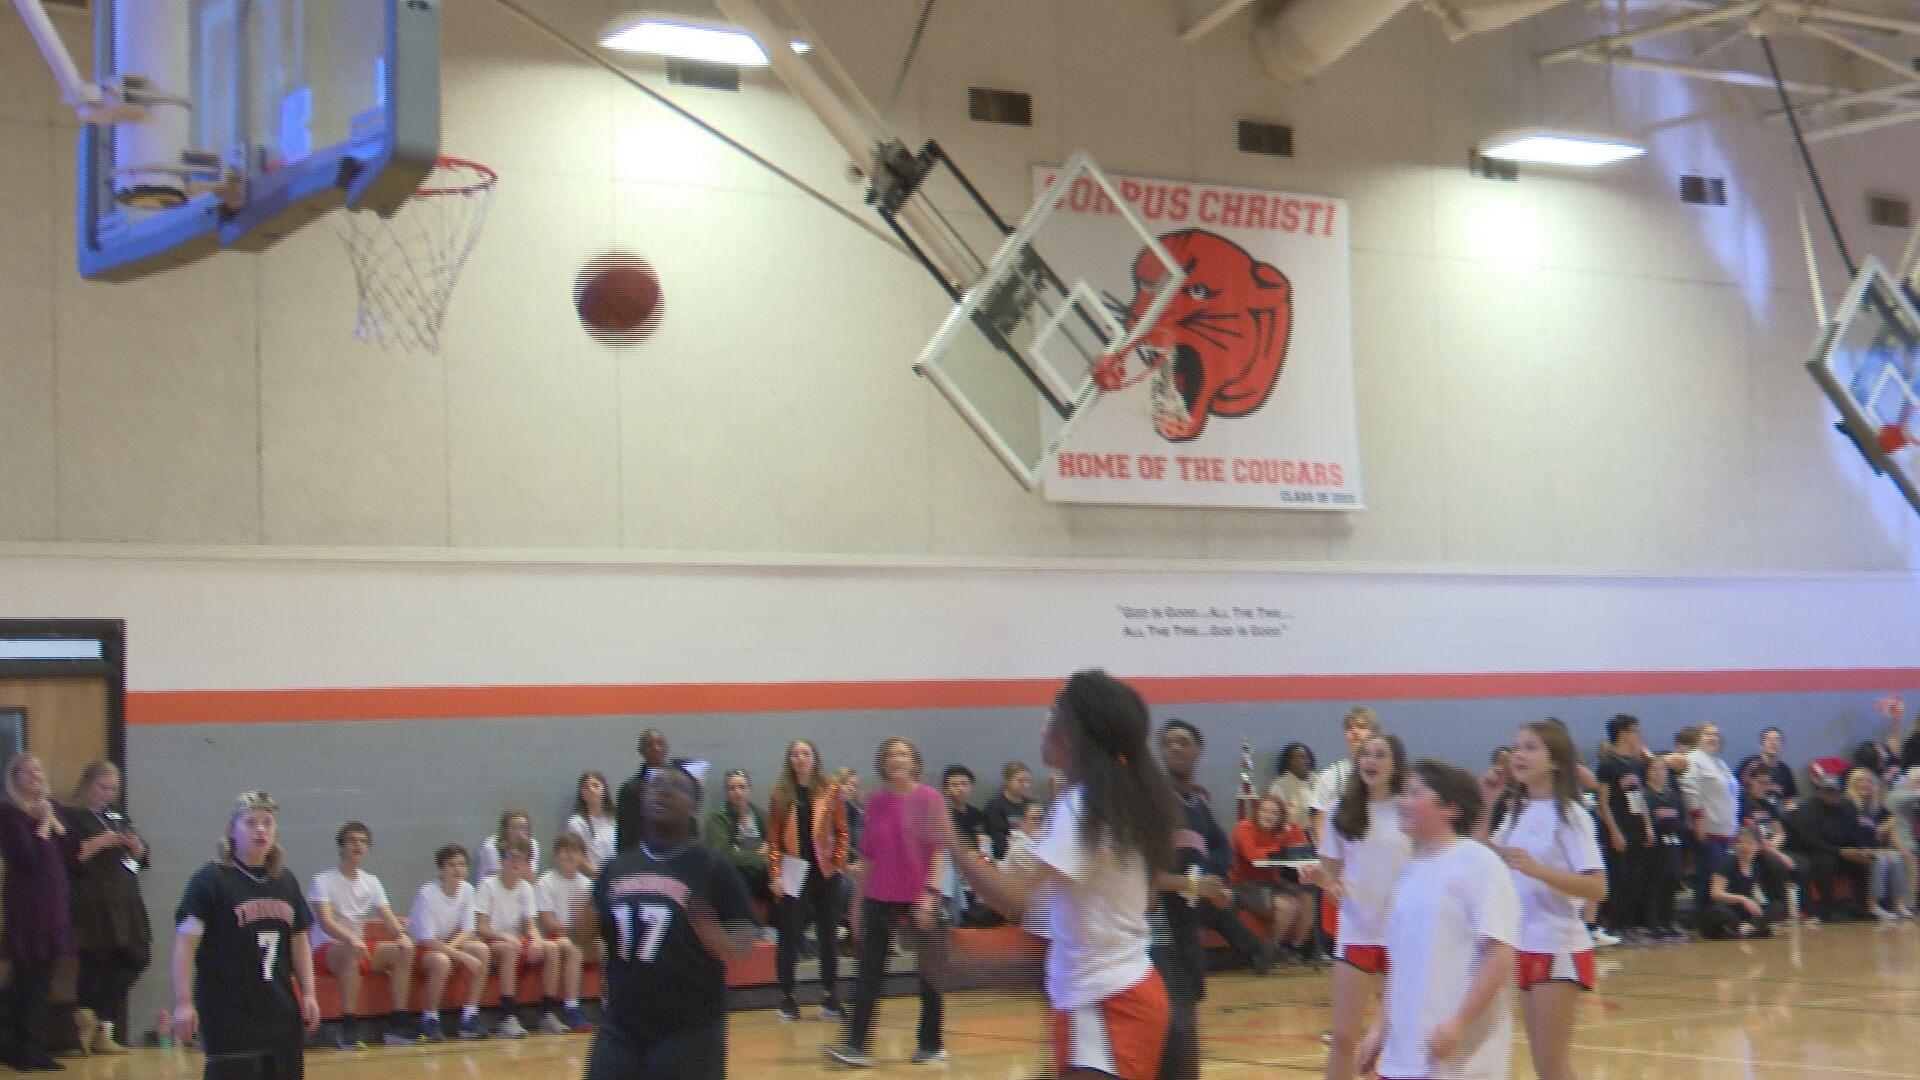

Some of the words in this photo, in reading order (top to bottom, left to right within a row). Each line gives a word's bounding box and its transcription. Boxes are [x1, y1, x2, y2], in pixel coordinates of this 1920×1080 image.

[1199, 189, 1338, 238] CHRISTI
[1056, 451, 1132, 480] HOME
[1136, 454, 1168, 481] OF
[1175, 455, 1226, 484] THE
[1230, 456, 1345, 487] COUGARS
[256, 931, 281, 981] 7
[610, 902, 674, 963] 17
